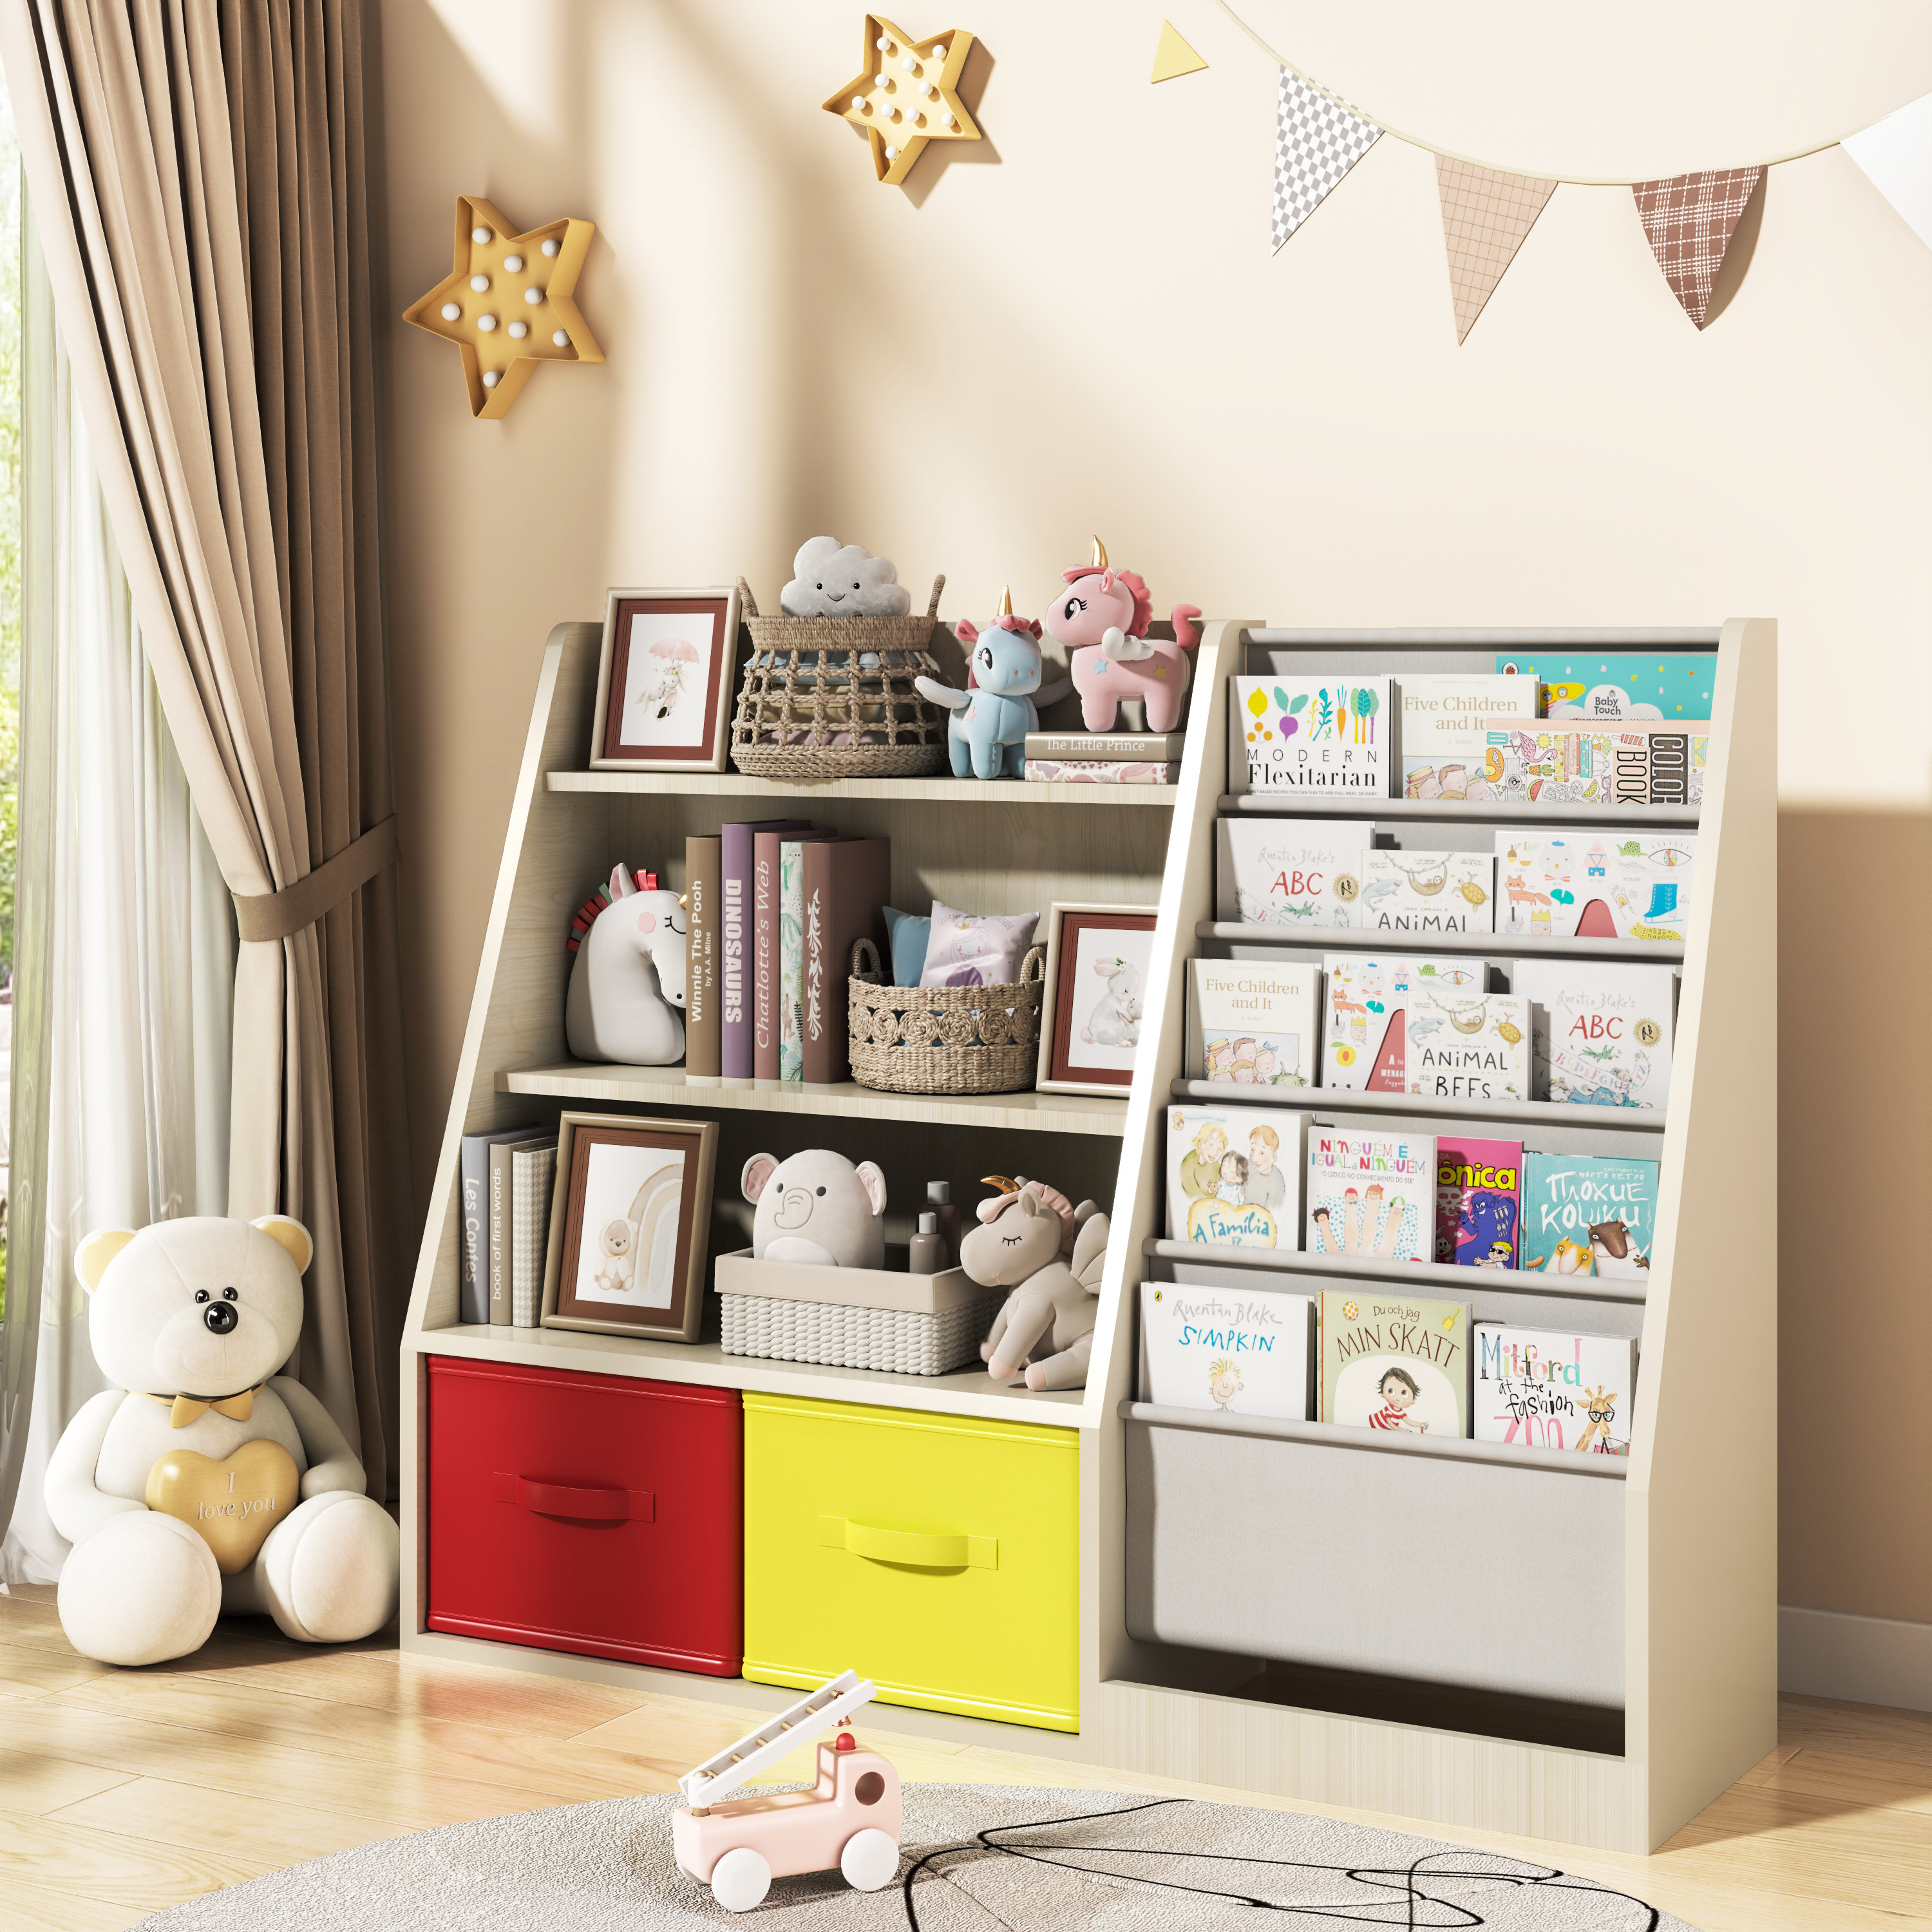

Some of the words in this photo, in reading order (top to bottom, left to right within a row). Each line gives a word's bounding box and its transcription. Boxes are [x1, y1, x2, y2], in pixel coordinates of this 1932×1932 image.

[1404, 696, 1439, 710] Five
[1443, 696, 1519, 711] Children
[1594, 706, 1621, 715] Touch
[1595, 697, 1618, 707] Baby
[1435, 715, 1468, 730] and
[1473, 716, 1486, 730] It
[1045, 738, 1066, 750] The
[1070, 739, 1103, 751] Little
[1106, 740, 1146, 752] Prince
[1247, 748, 1377, 762] MODERN
[1247, 763, 1378, 786] Flexitarian
[1616, 750, 1647, 804] BOOK
[1652, 737, 1684, 804] COLOR
[1258, 846, 1296, 871] Quentin
[1295, 849, 1335, 866] Blake's
[757, 860, 770, 911] Web
[1270, 871, 1323, 896] ABC
[692, 880, 702, 923] Pooh
[692, 929, 702, 961] The
[725, 879, 742, 1023] DINOSAURS
[705, 974, 712, 987] by
[1205, 979, 1235, 991] Five
[1238, 980, 1300, 994] Children
[692, 965, 702, 1022] Winnie
[1231, 997, 1258, 1009] and
[1262, 998, 1273, 1009] It
[1556, 990, 1595, 1015] Quentin
[1595, 992, 1636, 1010] Blake's
[1569, 1015, 1624, 1039] ABC
[1389, 1054, 1395, 1065] A
[1312, 1153, 1350, 1168] IGUAL
[1398, 1142, 1408, 1159] É
[1356, 1173, 1395, 1182] CONHECIMENTO
[1437, 1160, 1517, 1191] ônica
[1578, 1171, 1608, 1179] МАРТА
[1611, 1172, 1645, 1180] КЕТРО
[465, 1178, 480, 1211] Les
[493, 1168, 502, 1211] words
[493, 1215, 502, 1243] first
[1193, 1223, 1208, 1243] A
[1209, 1211, 1269, 1238] Família
[465, 1218, 480, 1283] Contes
[493, 1245, 502, 1261] of
[493, 1265, 502, 1300] book
[1173, 1298, 1231, 1322] Quentin
[1229, 1302, 1283, 1325] Blake
[1373, 1305, 1385, 1316] Du
[1388, 1305, 1403, 1315] och
[1401, 1307, 1420, 1322] jag
[1179, 1325, 1275, 1352] SIMPKIN
[1337, 1324, 1381, 1362] MIN
[1388, 1322, 1460, 1368] SKATT
[1479, 1332, 1583, 1387] Mitford
[1499, 1379, 1513, 1395] at
[1520, 1378, 1544, 1394] the
[1505, 1390, 1574, 1425] fashion
[227, 1472, 235, 1493] I
[198, 1501, 236, 1520] love
[240, 1497, 276, 1520] you
